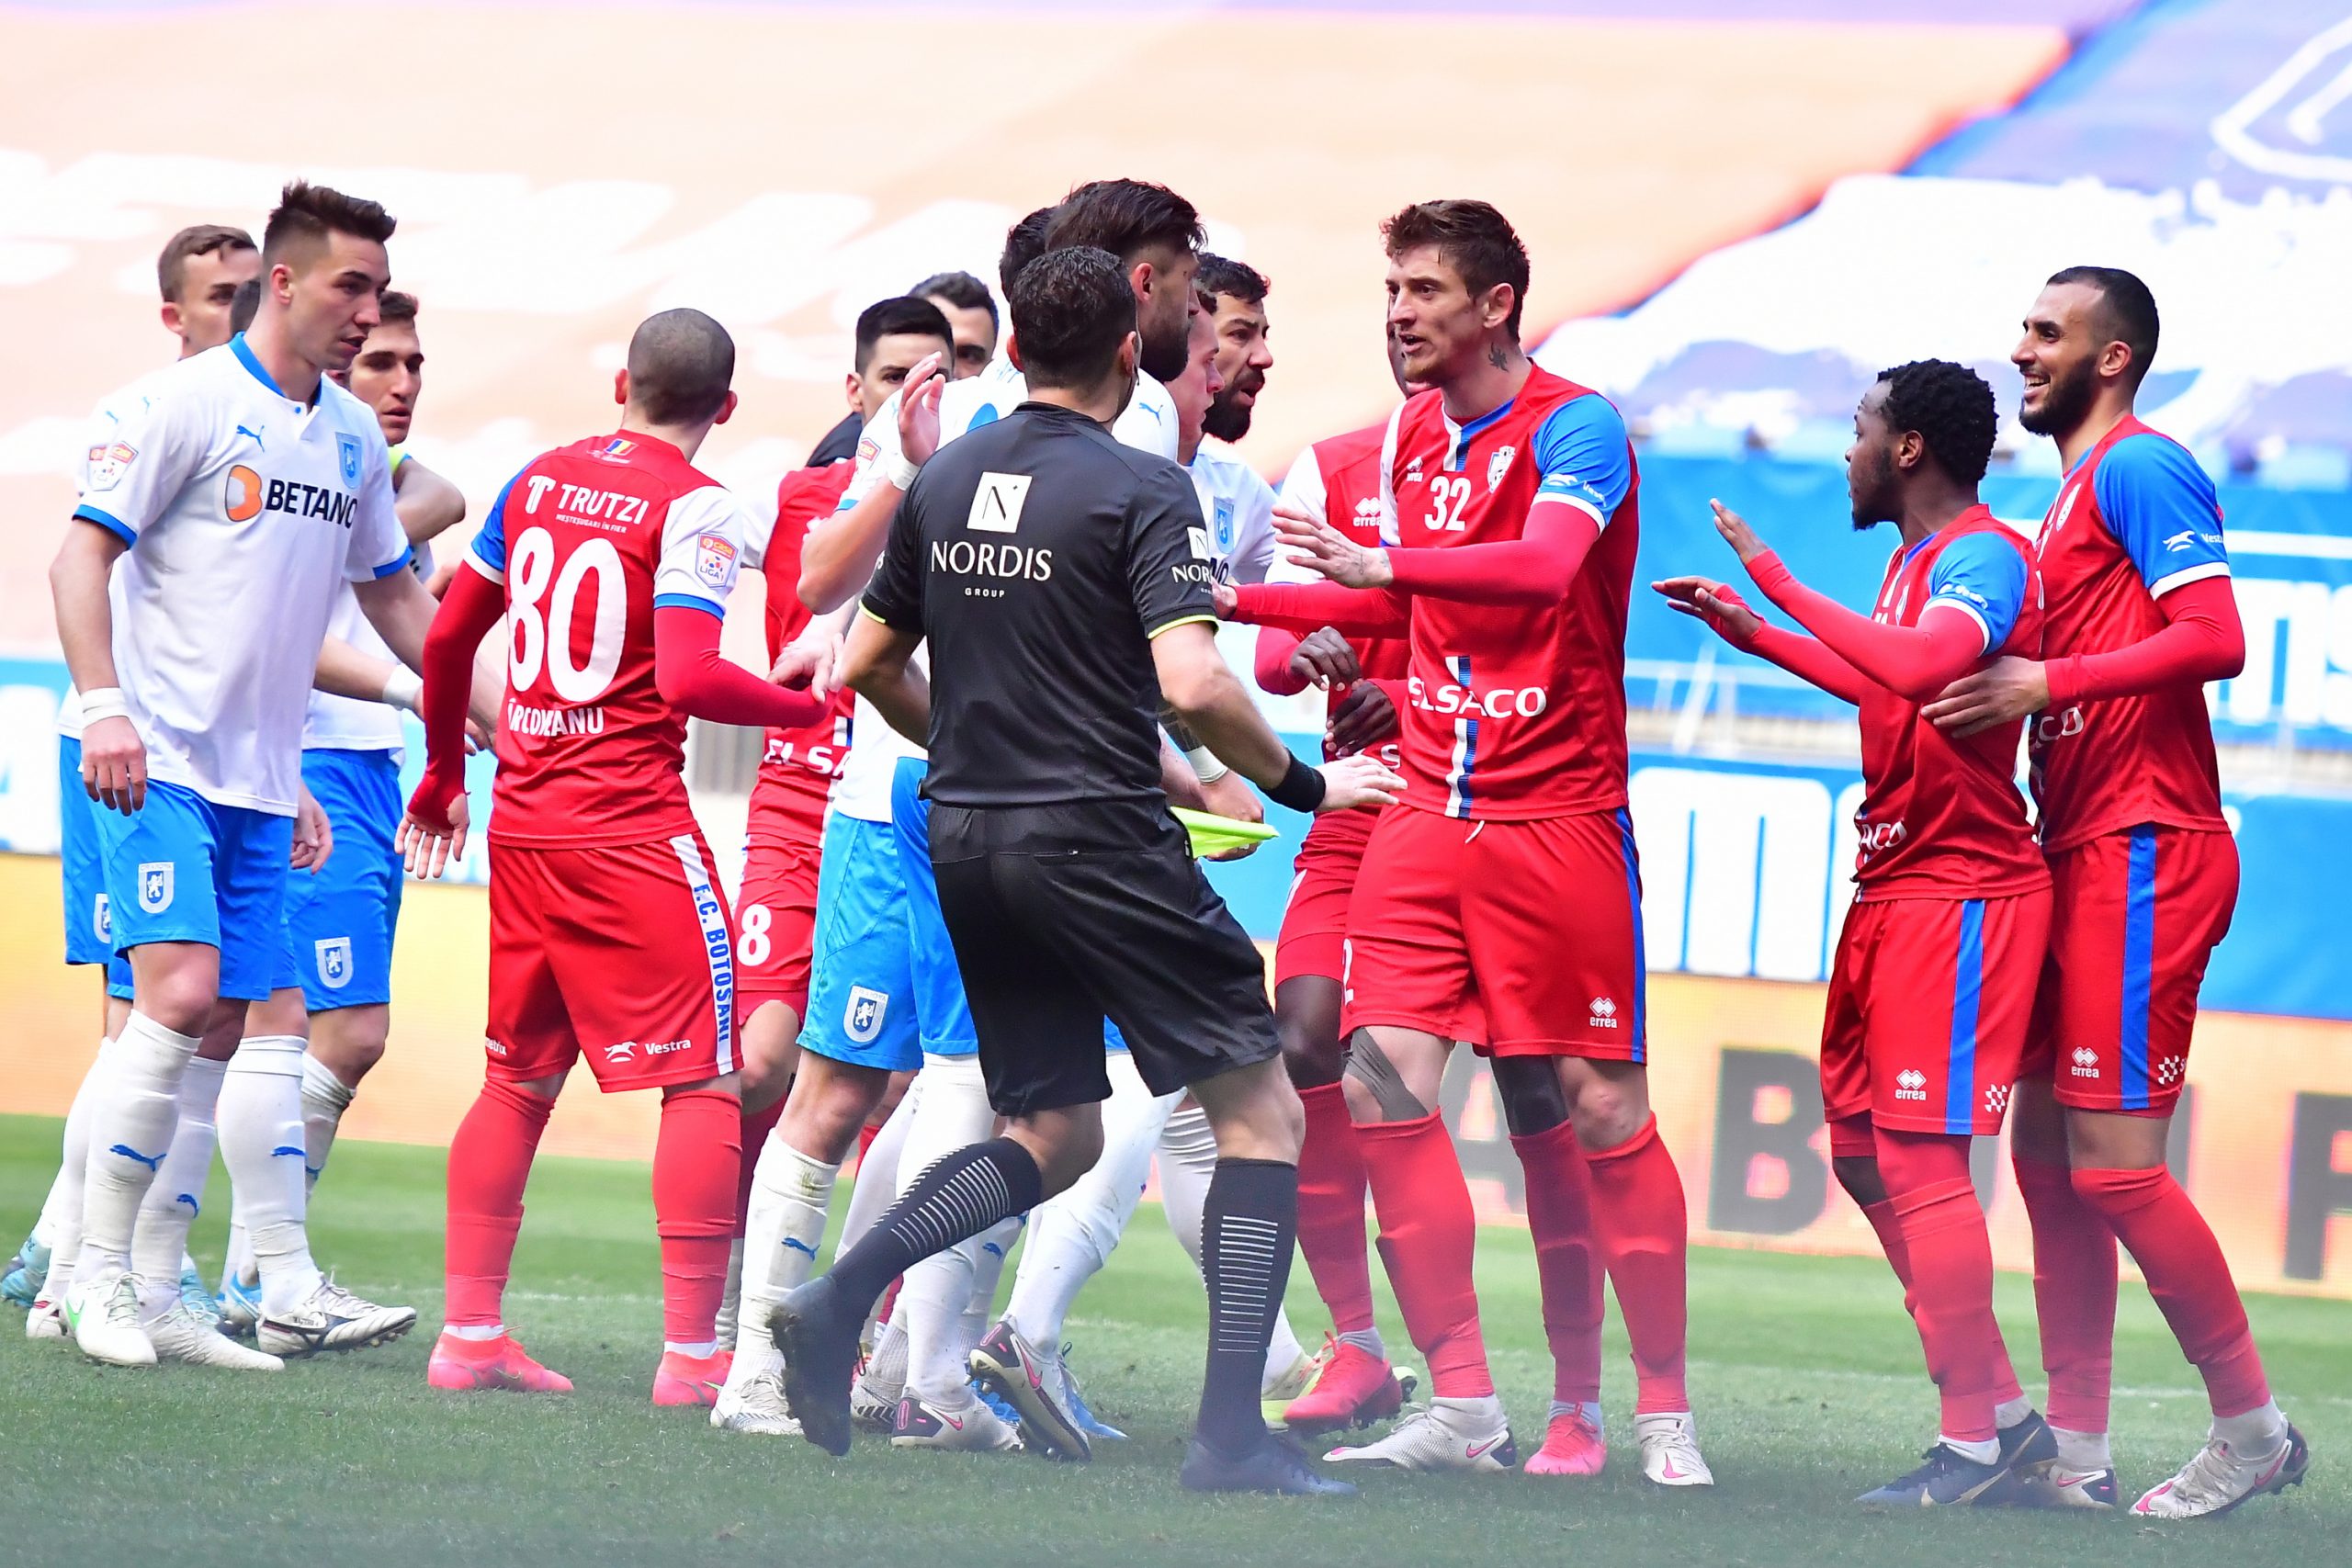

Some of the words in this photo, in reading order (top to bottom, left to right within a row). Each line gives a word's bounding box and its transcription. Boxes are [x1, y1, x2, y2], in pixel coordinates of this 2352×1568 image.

[558, 483, 650, 525] TRUTZI
[1424, 475, 1472, 531] 32
[931, 540, 1053, 581] NORDIS
[965, 587, 1005, 598] GROUP
[507, 526, 628, 703] 80
[736, 904, 772, 966] 8
[1589, 1016, 1617, 1029] errea
[645, 1039, 691, 1055] Vestra
[2071, 1066, 2099, 1079] errea
[1894, 1089, 1927, 1101] errea
